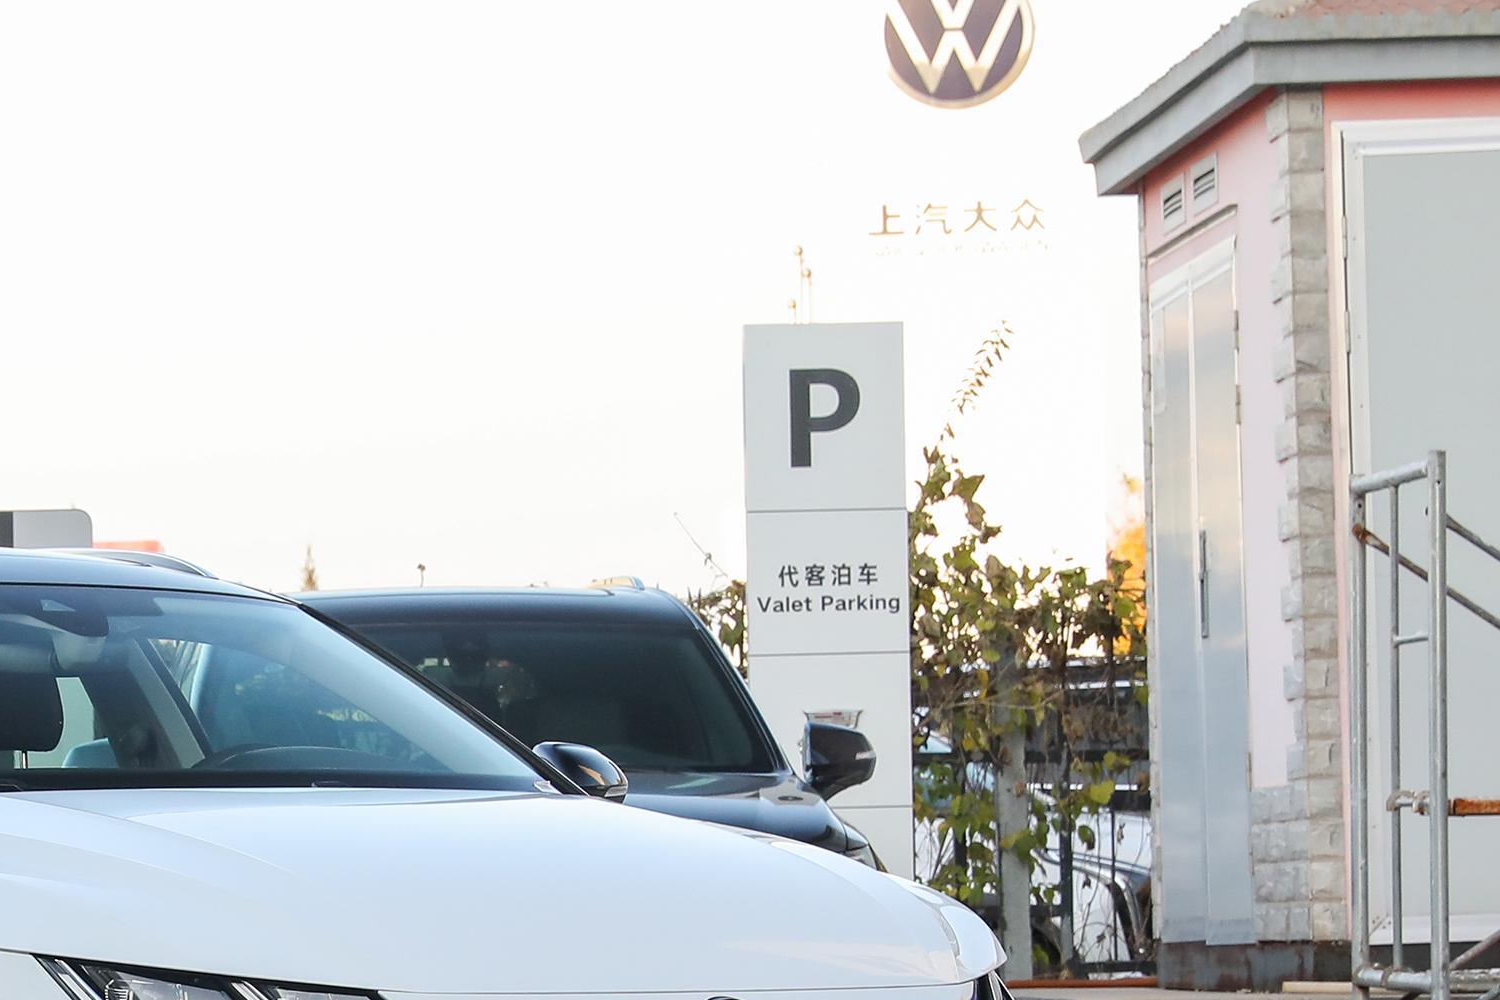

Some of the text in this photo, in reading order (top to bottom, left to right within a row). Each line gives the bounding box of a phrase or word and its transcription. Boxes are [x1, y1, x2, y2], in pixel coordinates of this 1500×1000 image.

[868, 199, 1046, 236] 上汽大众
[789, 368, 861, 467] P
[778, 563, 878, 588] 代客泊车
[757, 594, 900, 614] Valet Parking
